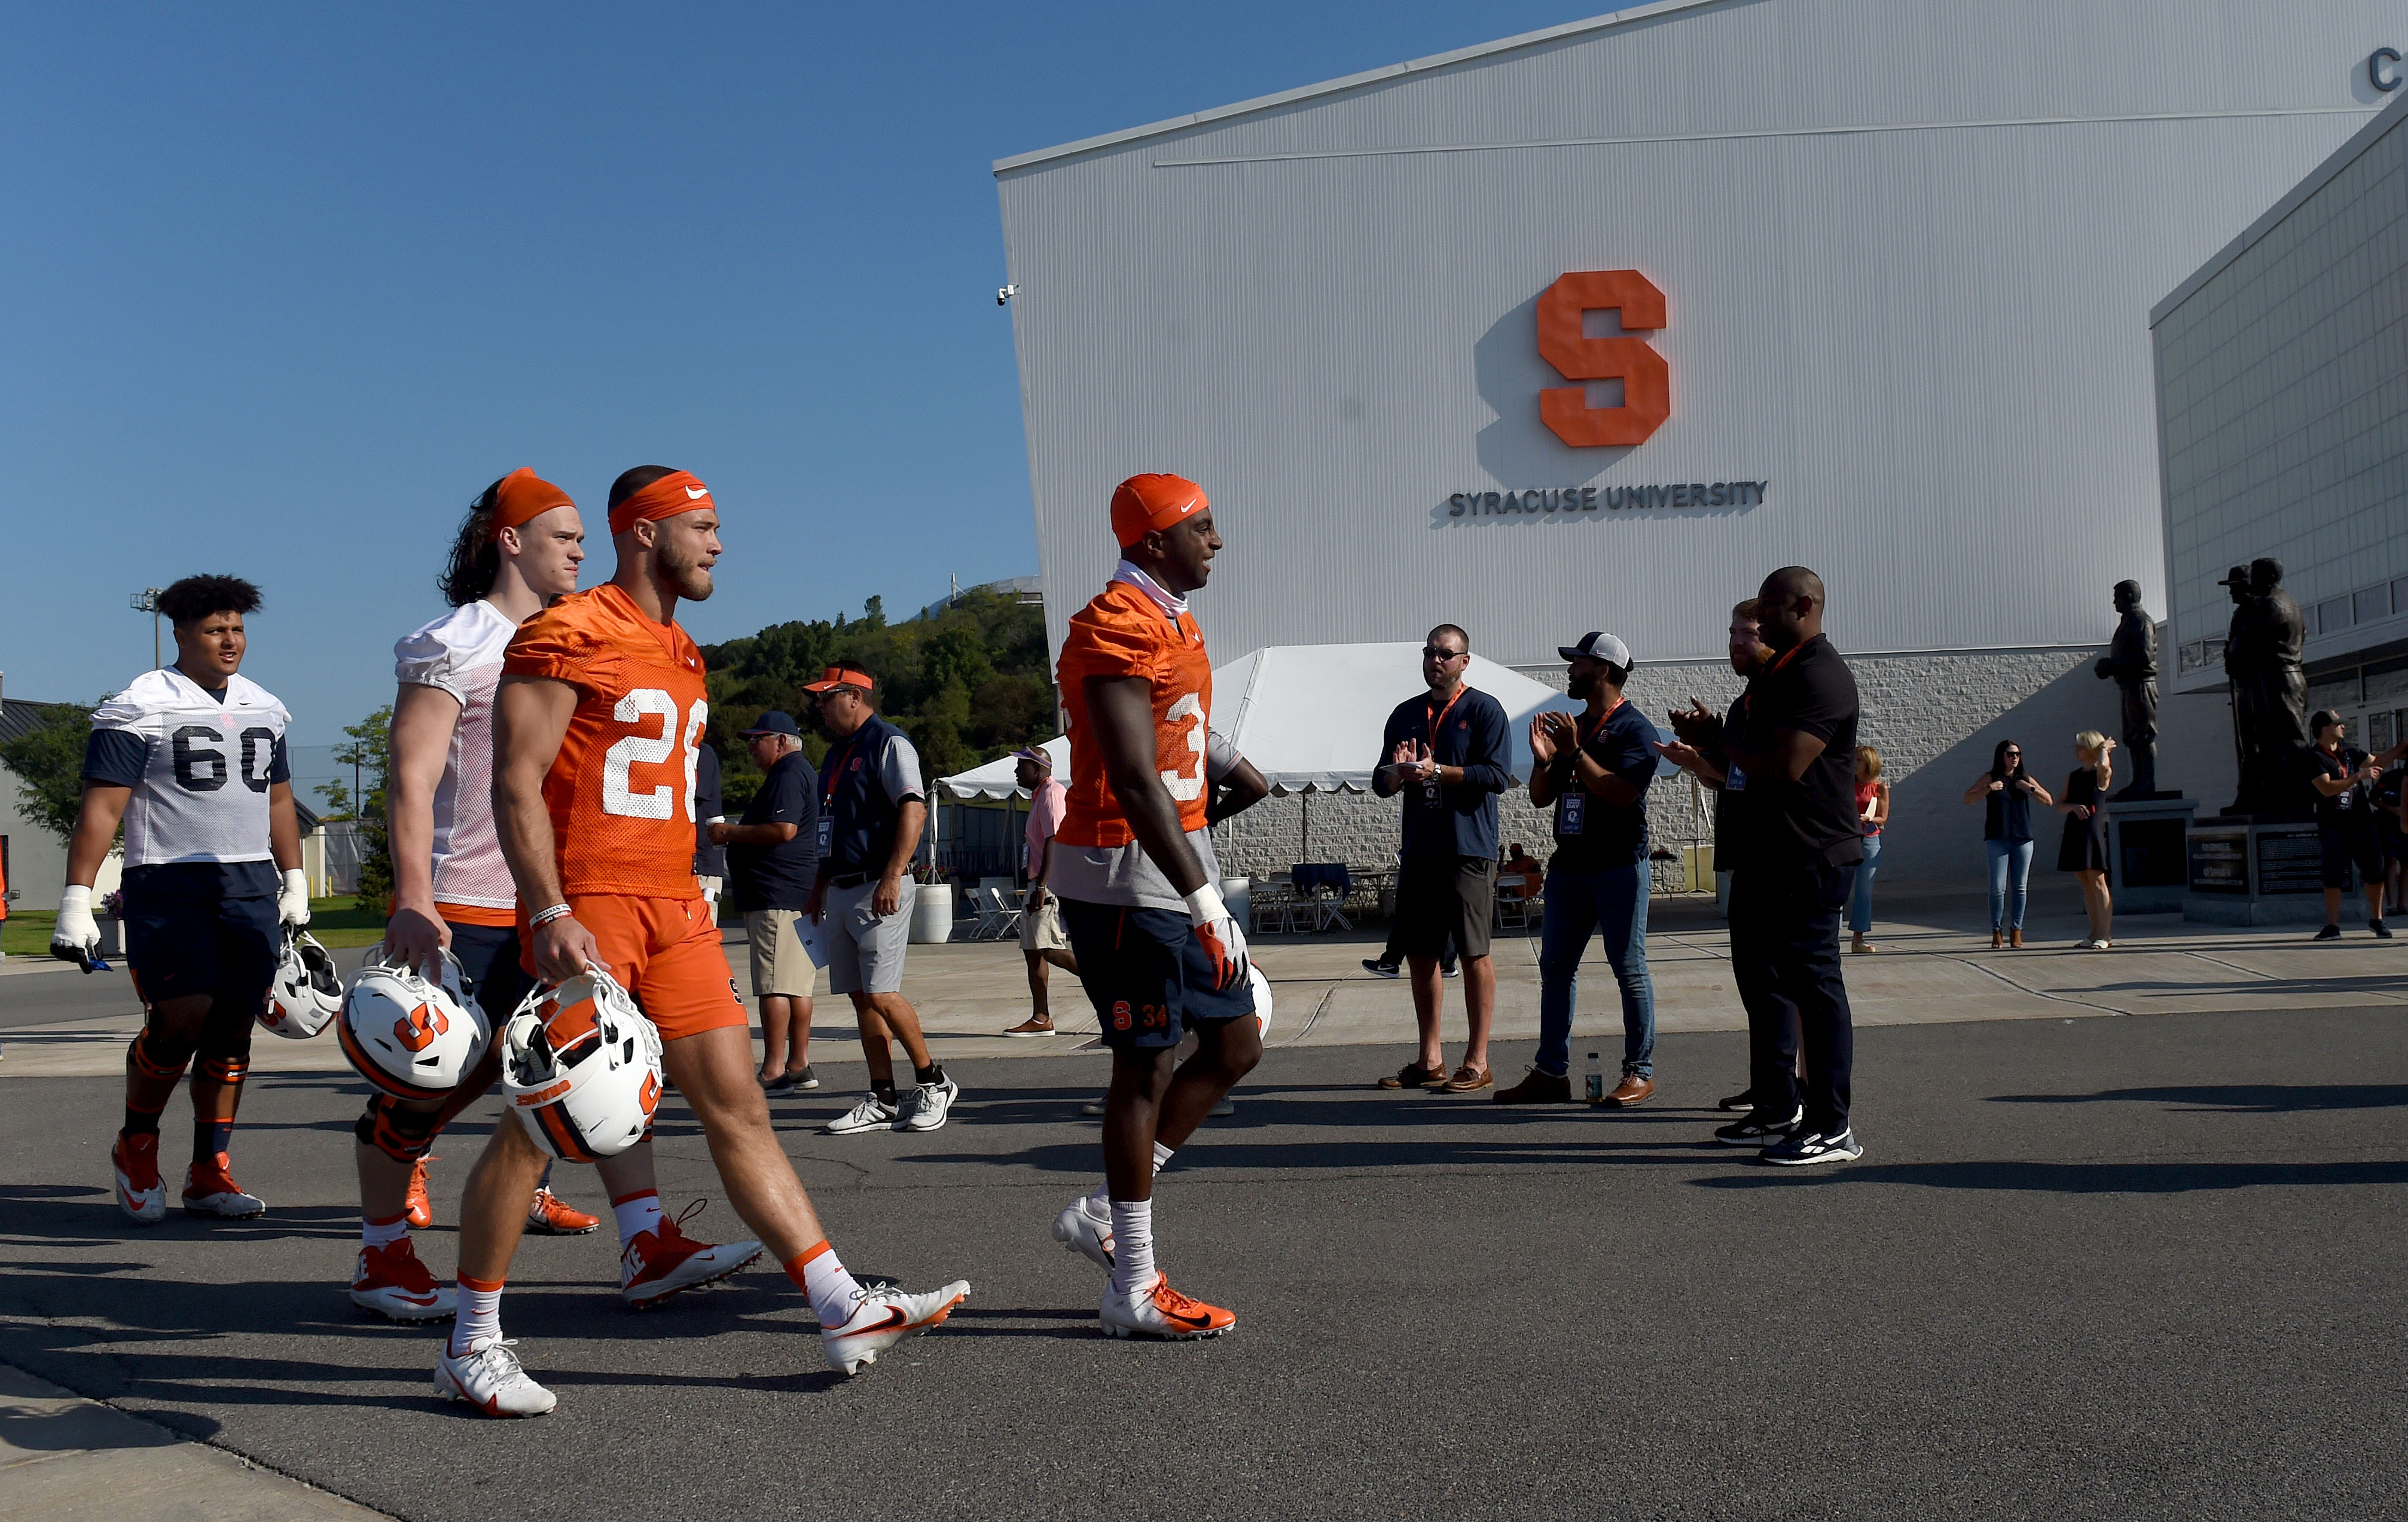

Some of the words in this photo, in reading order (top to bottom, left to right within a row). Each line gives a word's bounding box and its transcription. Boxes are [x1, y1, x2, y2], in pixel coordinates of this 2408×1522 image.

[2370, 47, 2403, 91] C
[1536, 269, 1671, 448] S
[1449, 487, 1598, 517] SYRACUSE
[1606, 479, 1768, 510] UNIVERSITY
[172, 725, 277, 793] 60
[850, 757, 863, 771] S
[393, 1002, 449, 1053] S
[1113, 1000, 1132, 1030] S
[1141, 1004, 1168, 1028] 34
[515, 1079, 572, 1107] ORANGE
[622, 1243, 646, 1287] IKE
